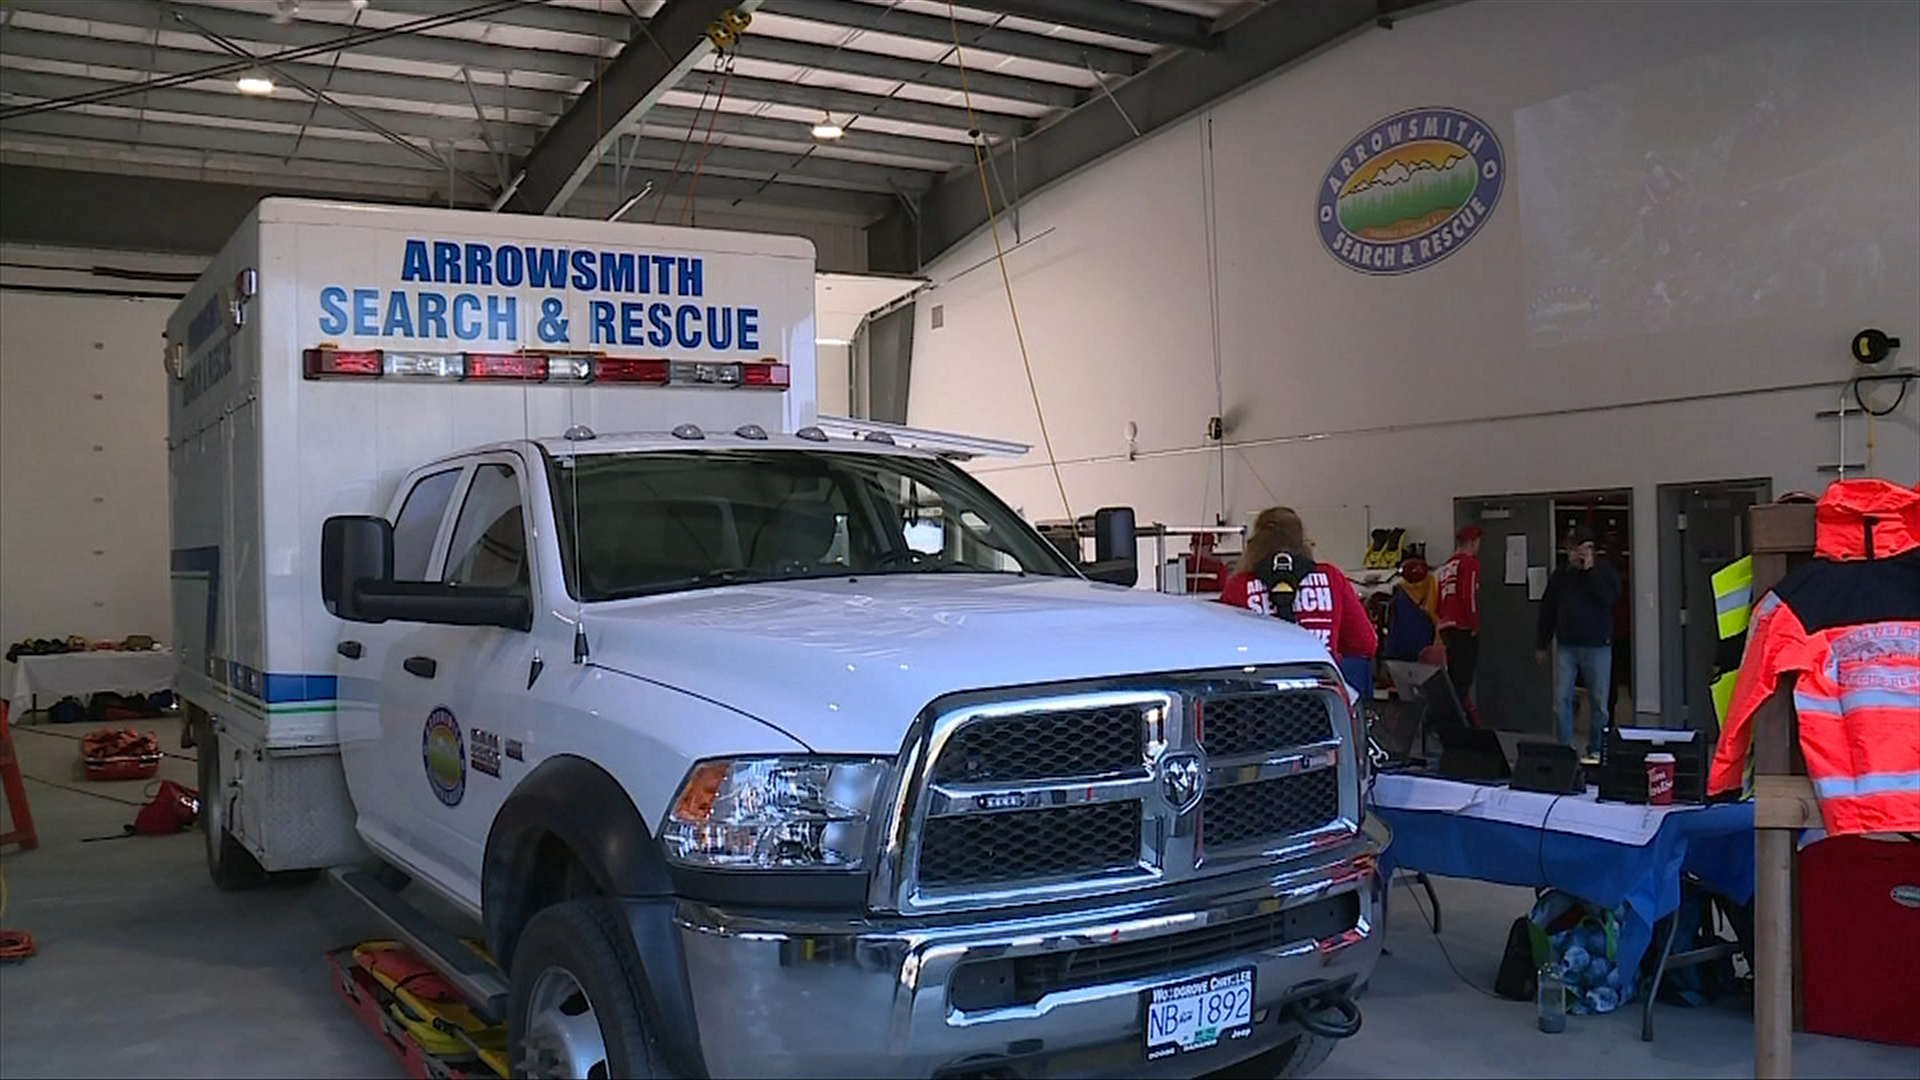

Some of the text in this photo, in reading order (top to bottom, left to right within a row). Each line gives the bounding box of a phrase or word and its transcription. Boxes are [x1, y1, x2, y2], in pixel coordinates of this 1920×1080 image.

[1328, 116, 1485, 195] ARROWSMITH
[1333, 197, 1487, 267] SEARCH & RESCUE
[401, 239, 703, 297] ARROWSMITH
[319, 286, 759, 351] SEARCH & RESCUE
[1150, 987, 1250, 1040] NB 1892
